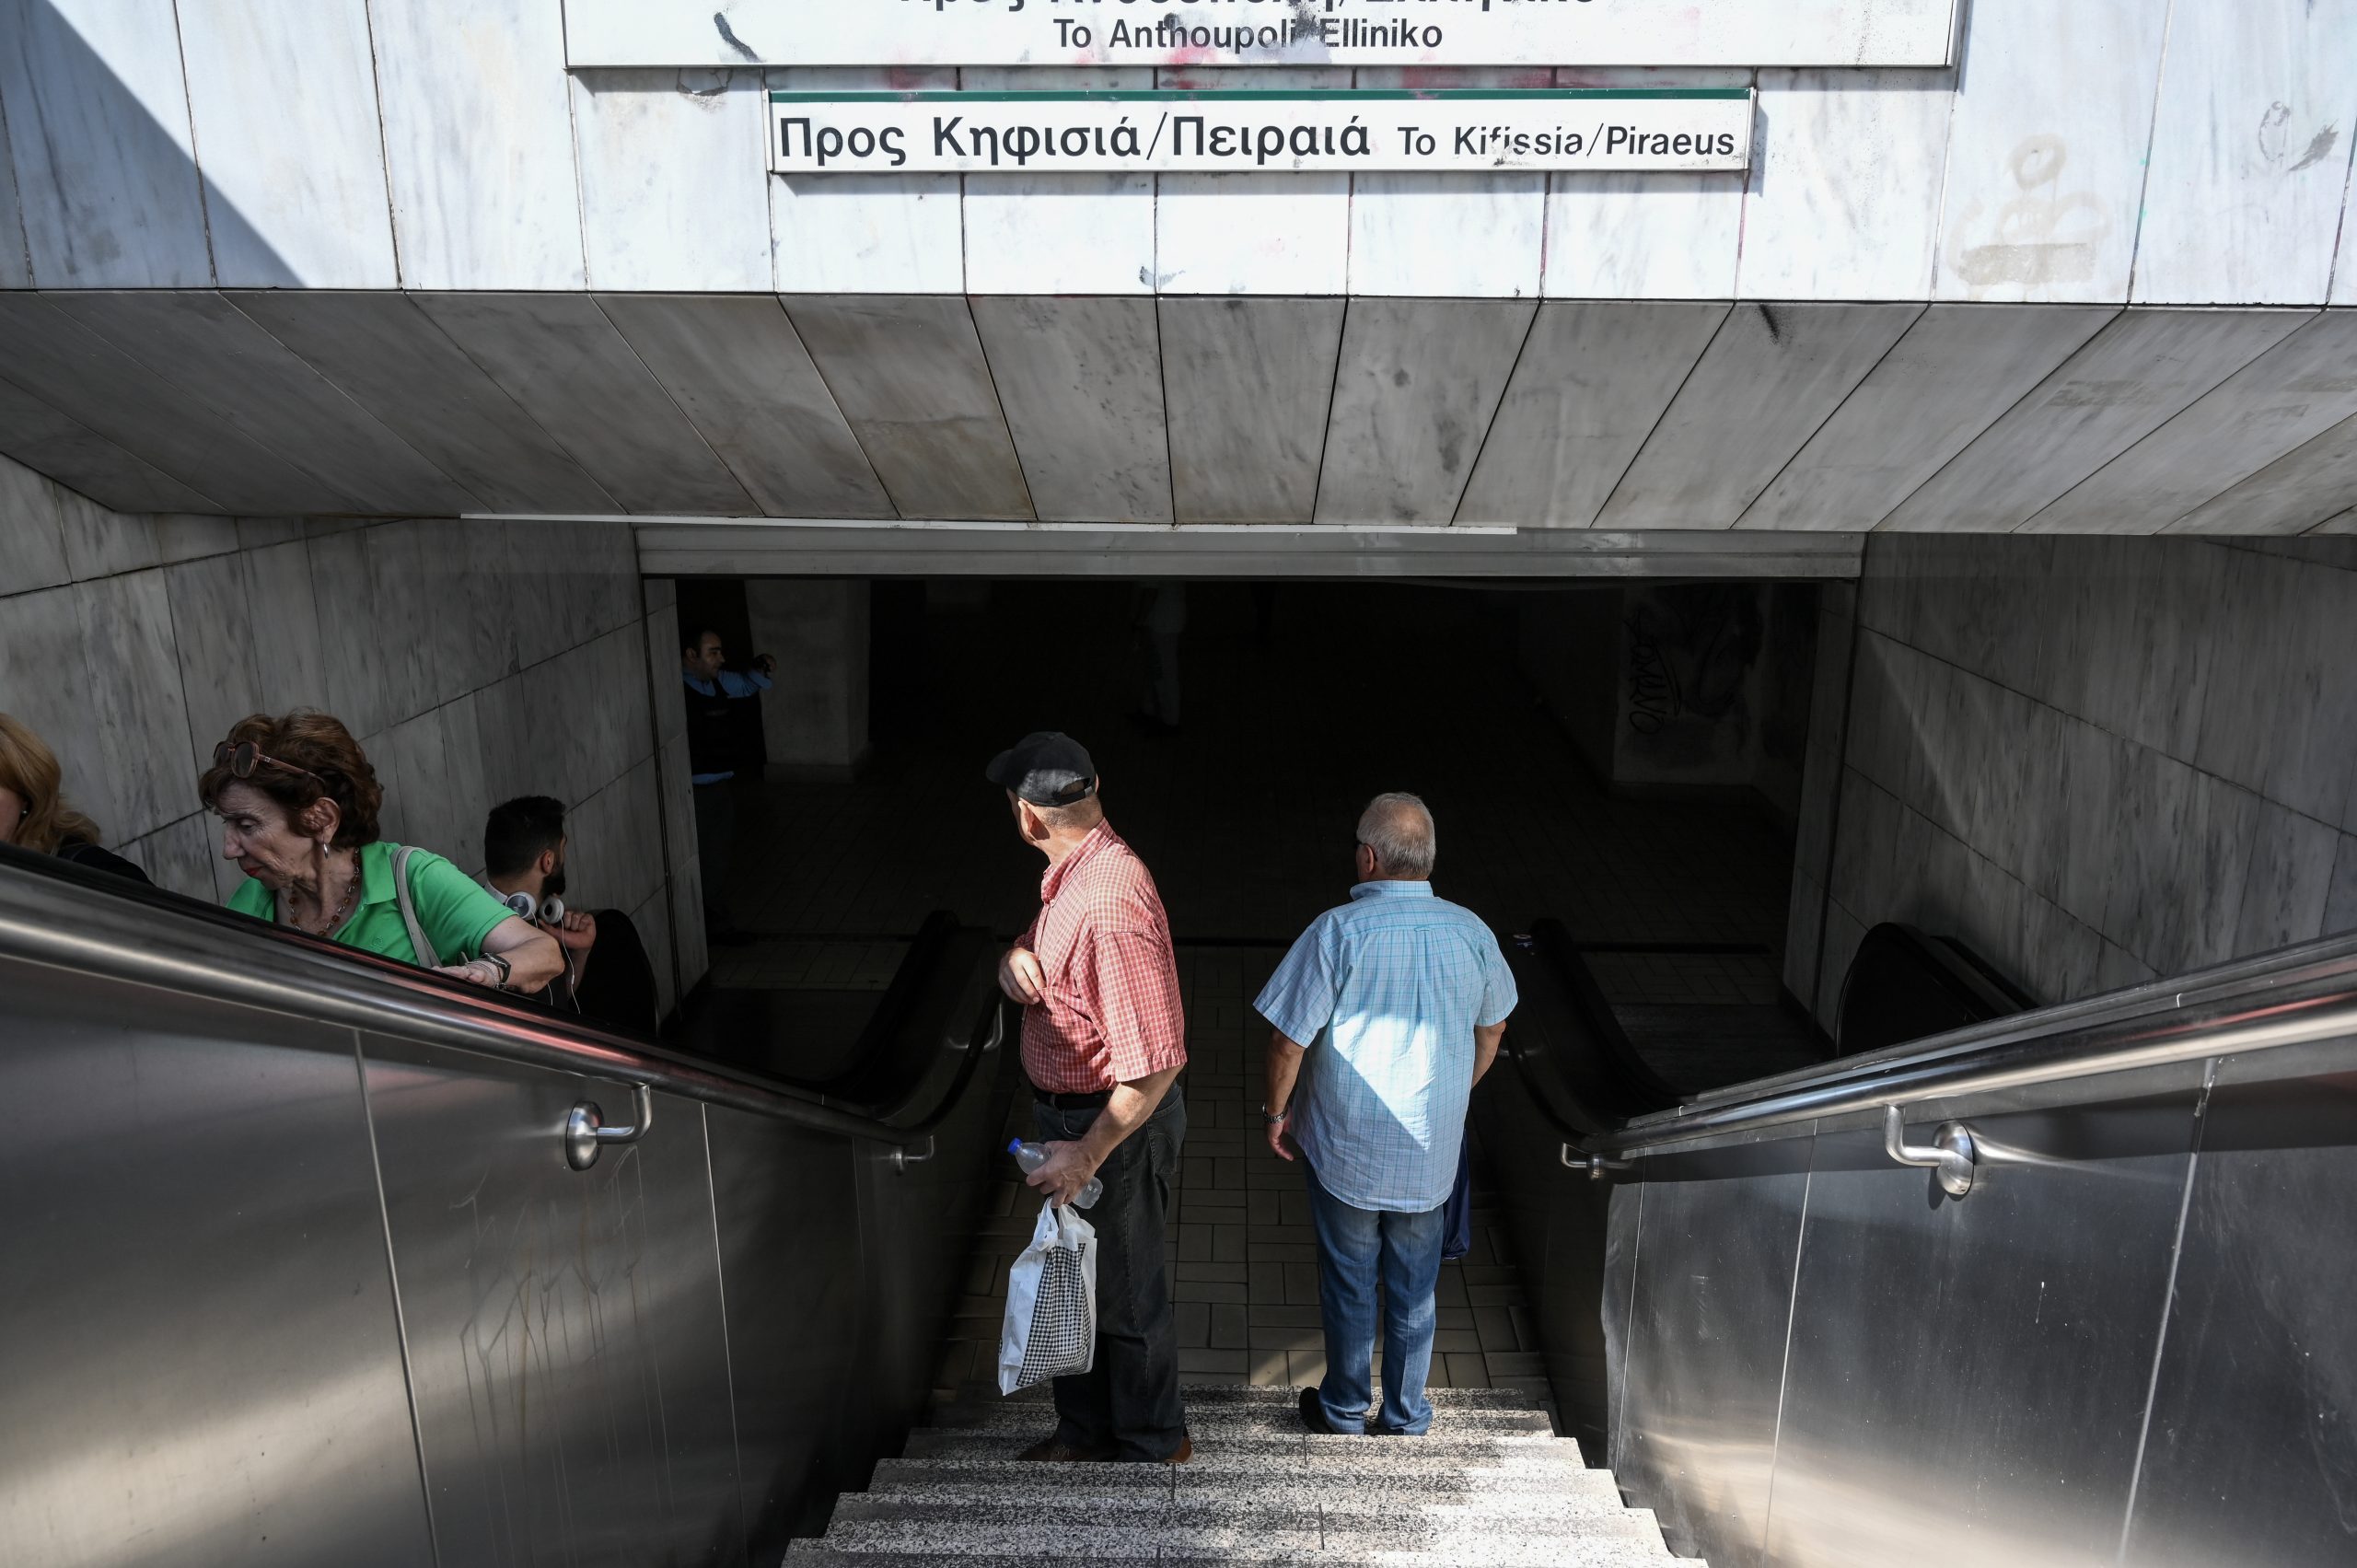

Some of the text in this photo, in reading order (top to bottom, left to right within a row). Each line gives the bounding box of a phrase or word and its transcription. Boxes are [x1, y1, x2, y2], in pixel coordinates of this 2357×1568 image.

[1053, 18, 1092, 48] To
[781, 111, 1371, 166] Προς Κηφισιά/Πειραιά
[1397, 122, 1735, 157] To Kifissia/Piraeus
